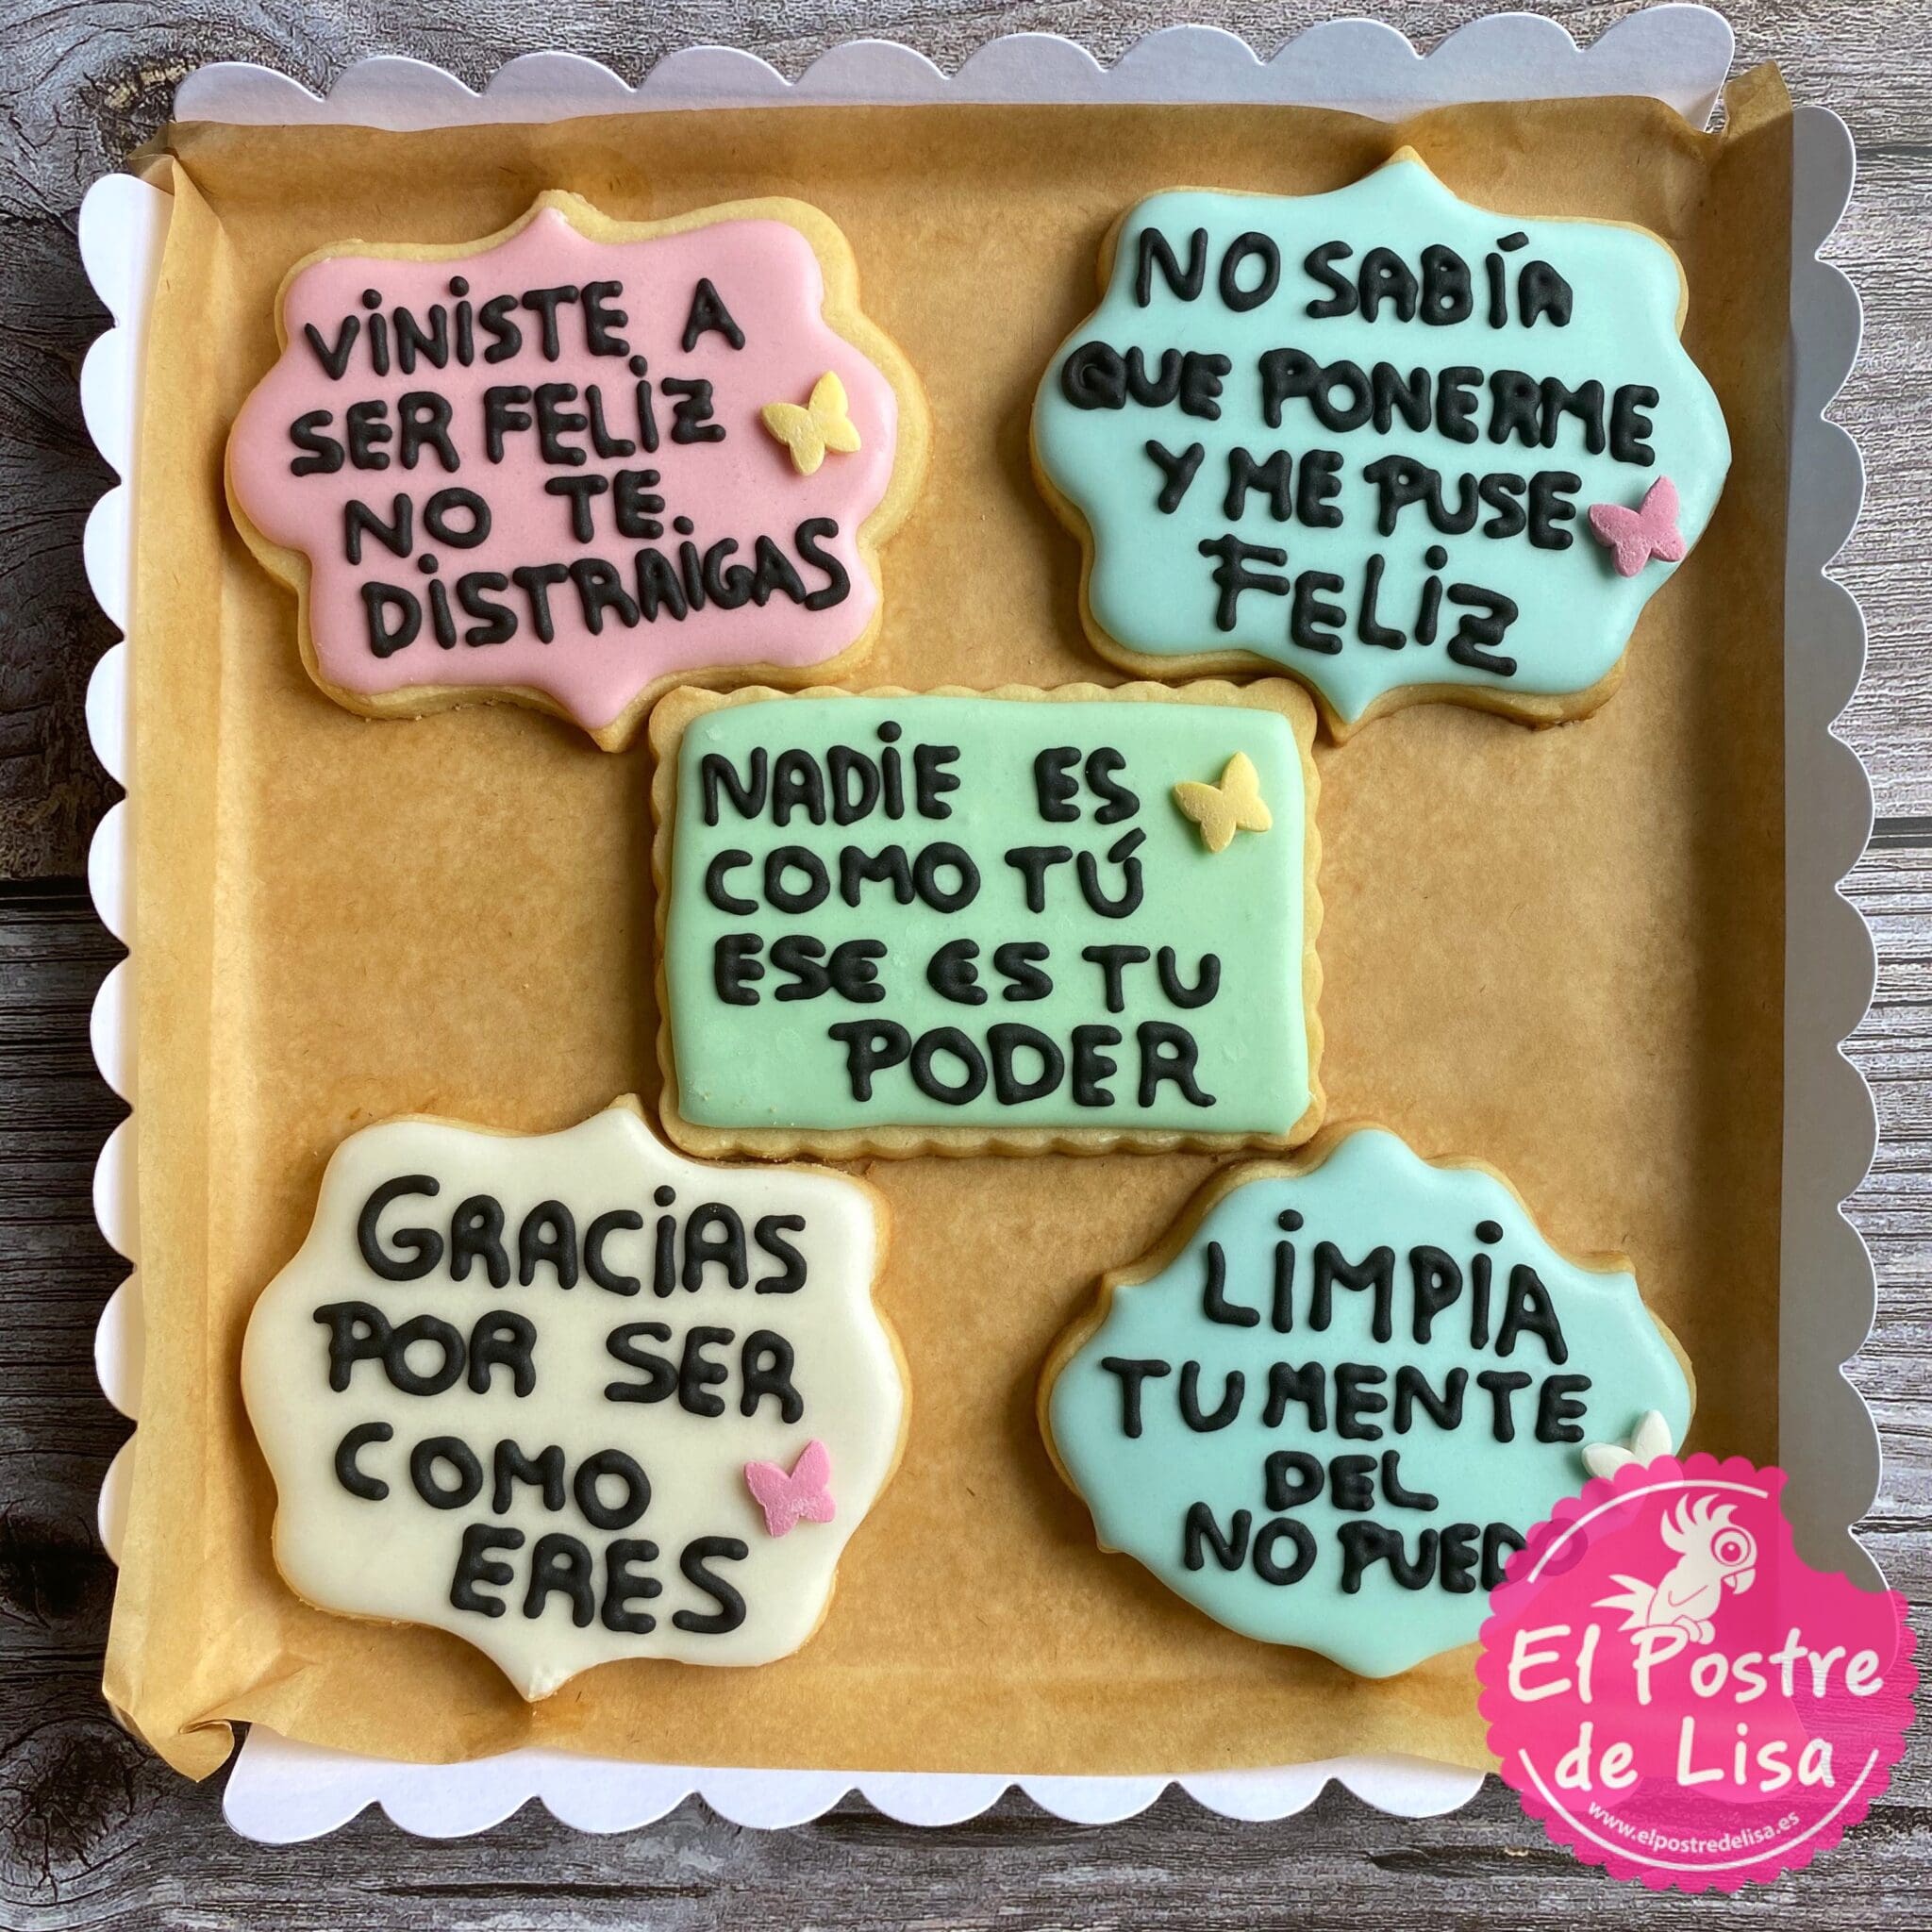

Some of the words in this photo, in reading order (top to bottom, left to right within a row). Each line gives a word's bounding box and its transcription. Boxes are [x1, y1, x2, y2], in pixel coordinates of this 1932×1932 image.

[680, 278, 745, 353] A
[1134, 228, 1281, 312] NO
[1304, 232, 1574, 329] SABÍA
[289, 390, 460, 477] SER
[1060, 340, 1232, 422] QUE
[1257, 347, 1660, 467] PONERME
[342, 487, 492, 566] NO
[544, 469, 666, 544] TE
[1144, 440, 1205, 514] Y
[1223, 447, 1344, 528] ME
[1363, 455, 1583, 550] PUSE
[1035, 746, 1141, 824] ES
[705, 841, 981, 916] COMO
[1005, 827, 1147, 918] TÚ
[714, 933, 888, 1006] ESE
[926, 939, 1054, 1006] ES
[1082, 944, 1221, 1013] TU
[828, 1019, 1217, 1108] PODER
[313, 1301, 537, 1397] POR
[604, 1323, 804, 1424] SER
[1101, 1357, 1245, 1439] TU
[1262, 1362, 1592, 1443] MENTE
[335, 1423, 652, 1530] COMO
[1264, 1450, 1440, 1512] DEL
[450, 1524, 748, 1634] ERES
[1183, 1502, 1318, 1586] NO
